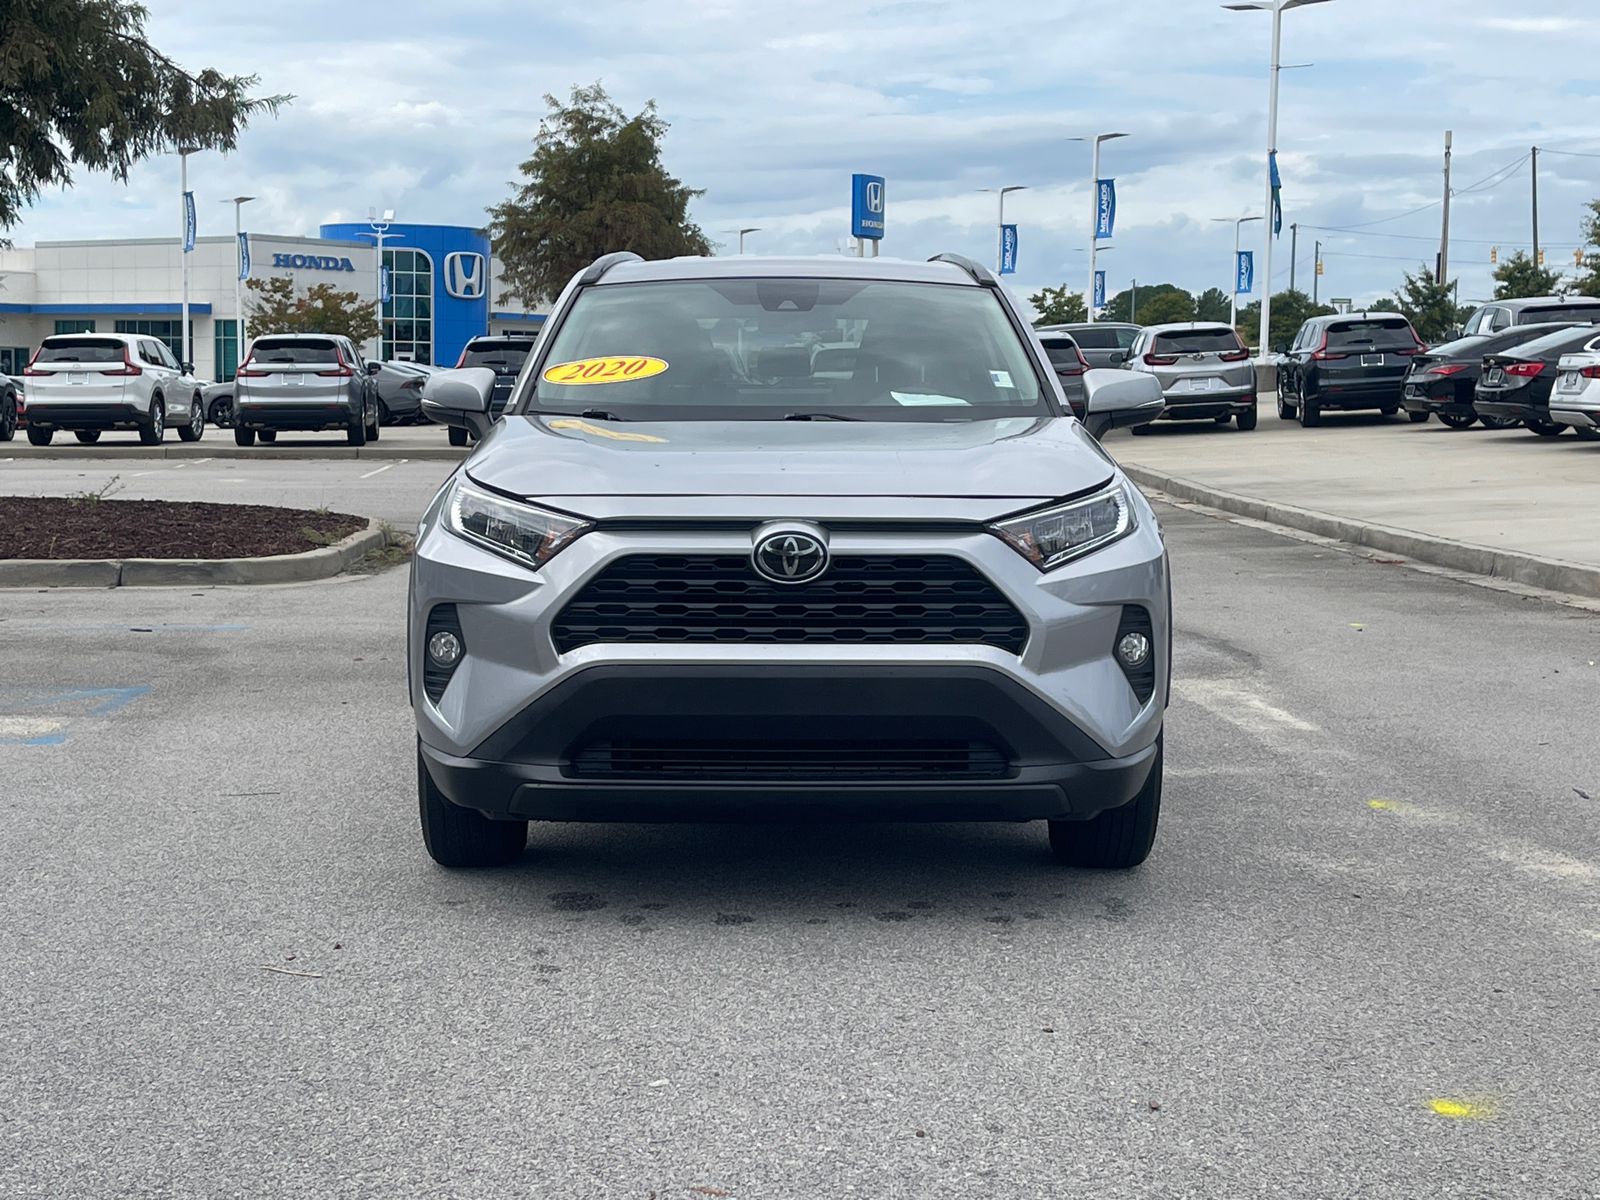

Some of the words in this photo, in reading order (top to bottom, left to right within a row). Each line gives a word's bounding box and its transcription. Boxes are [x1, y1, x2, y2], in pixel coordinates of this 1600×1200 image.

[1099, 184, 1107, 233] MIDLANDS
[272, 253, 355, 271] HONDA
[560, 360, 647, 380] 2020
